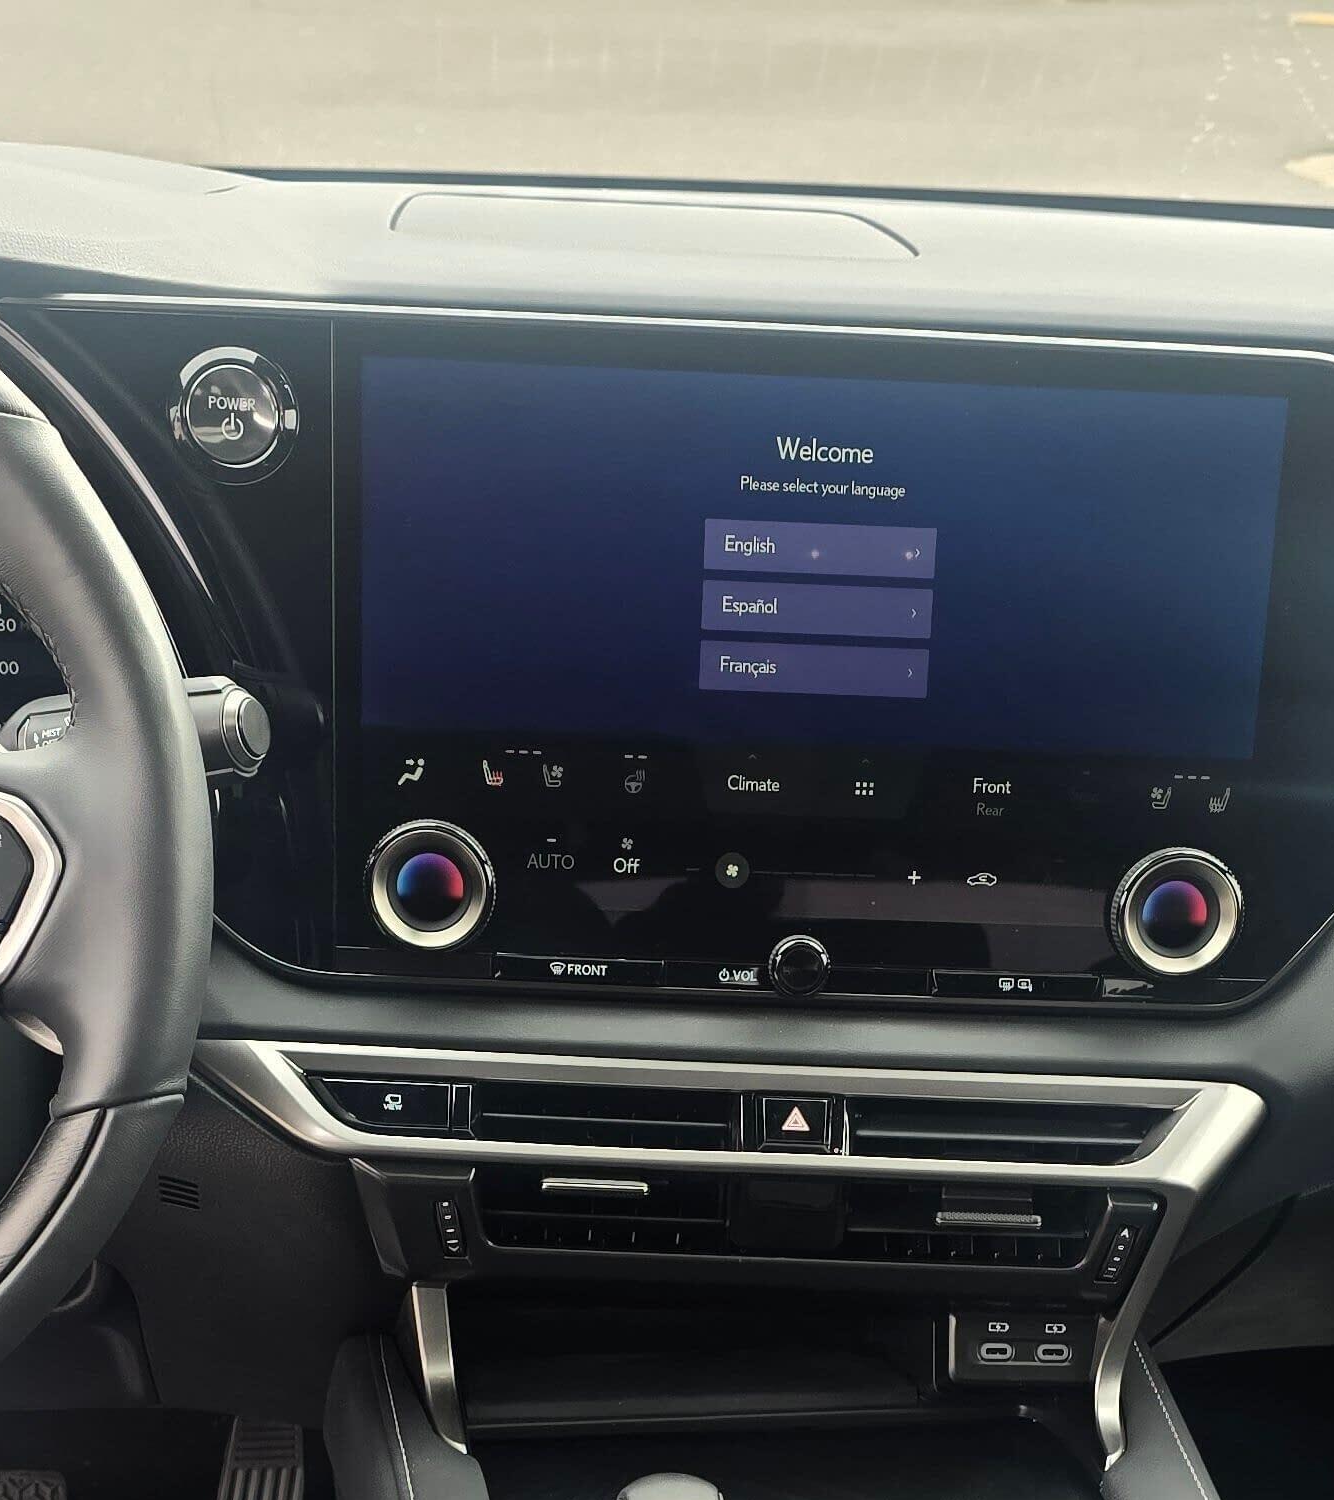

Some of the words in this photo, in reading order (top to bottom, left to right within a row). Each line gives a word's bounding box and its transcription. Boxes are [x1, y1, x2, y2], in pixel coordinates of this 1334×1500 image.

[208, 396, 256, 411] POWER
[776, 437, 874, 464] Welcome
[740, 476, 779, 492] Please
[782, 479, 818, 494] select
[821, 482, 849, 497] your
[851, 481, 905, 499] language
[724, 535, 776, 556] English
[722, 596, 778, 618] Español
[720, 655, 777, 678] Français
[727, 775, 780, 793] Climate
[973, 778, 1011, 795] Front
[976, 803, 1004, 818] Rear
[527, 854, 575, 871] AUTO
[613, 858, 640, 875] Off
[567, 963, 608, 977] FRONT
[732, 970, 758, 983] VOL
